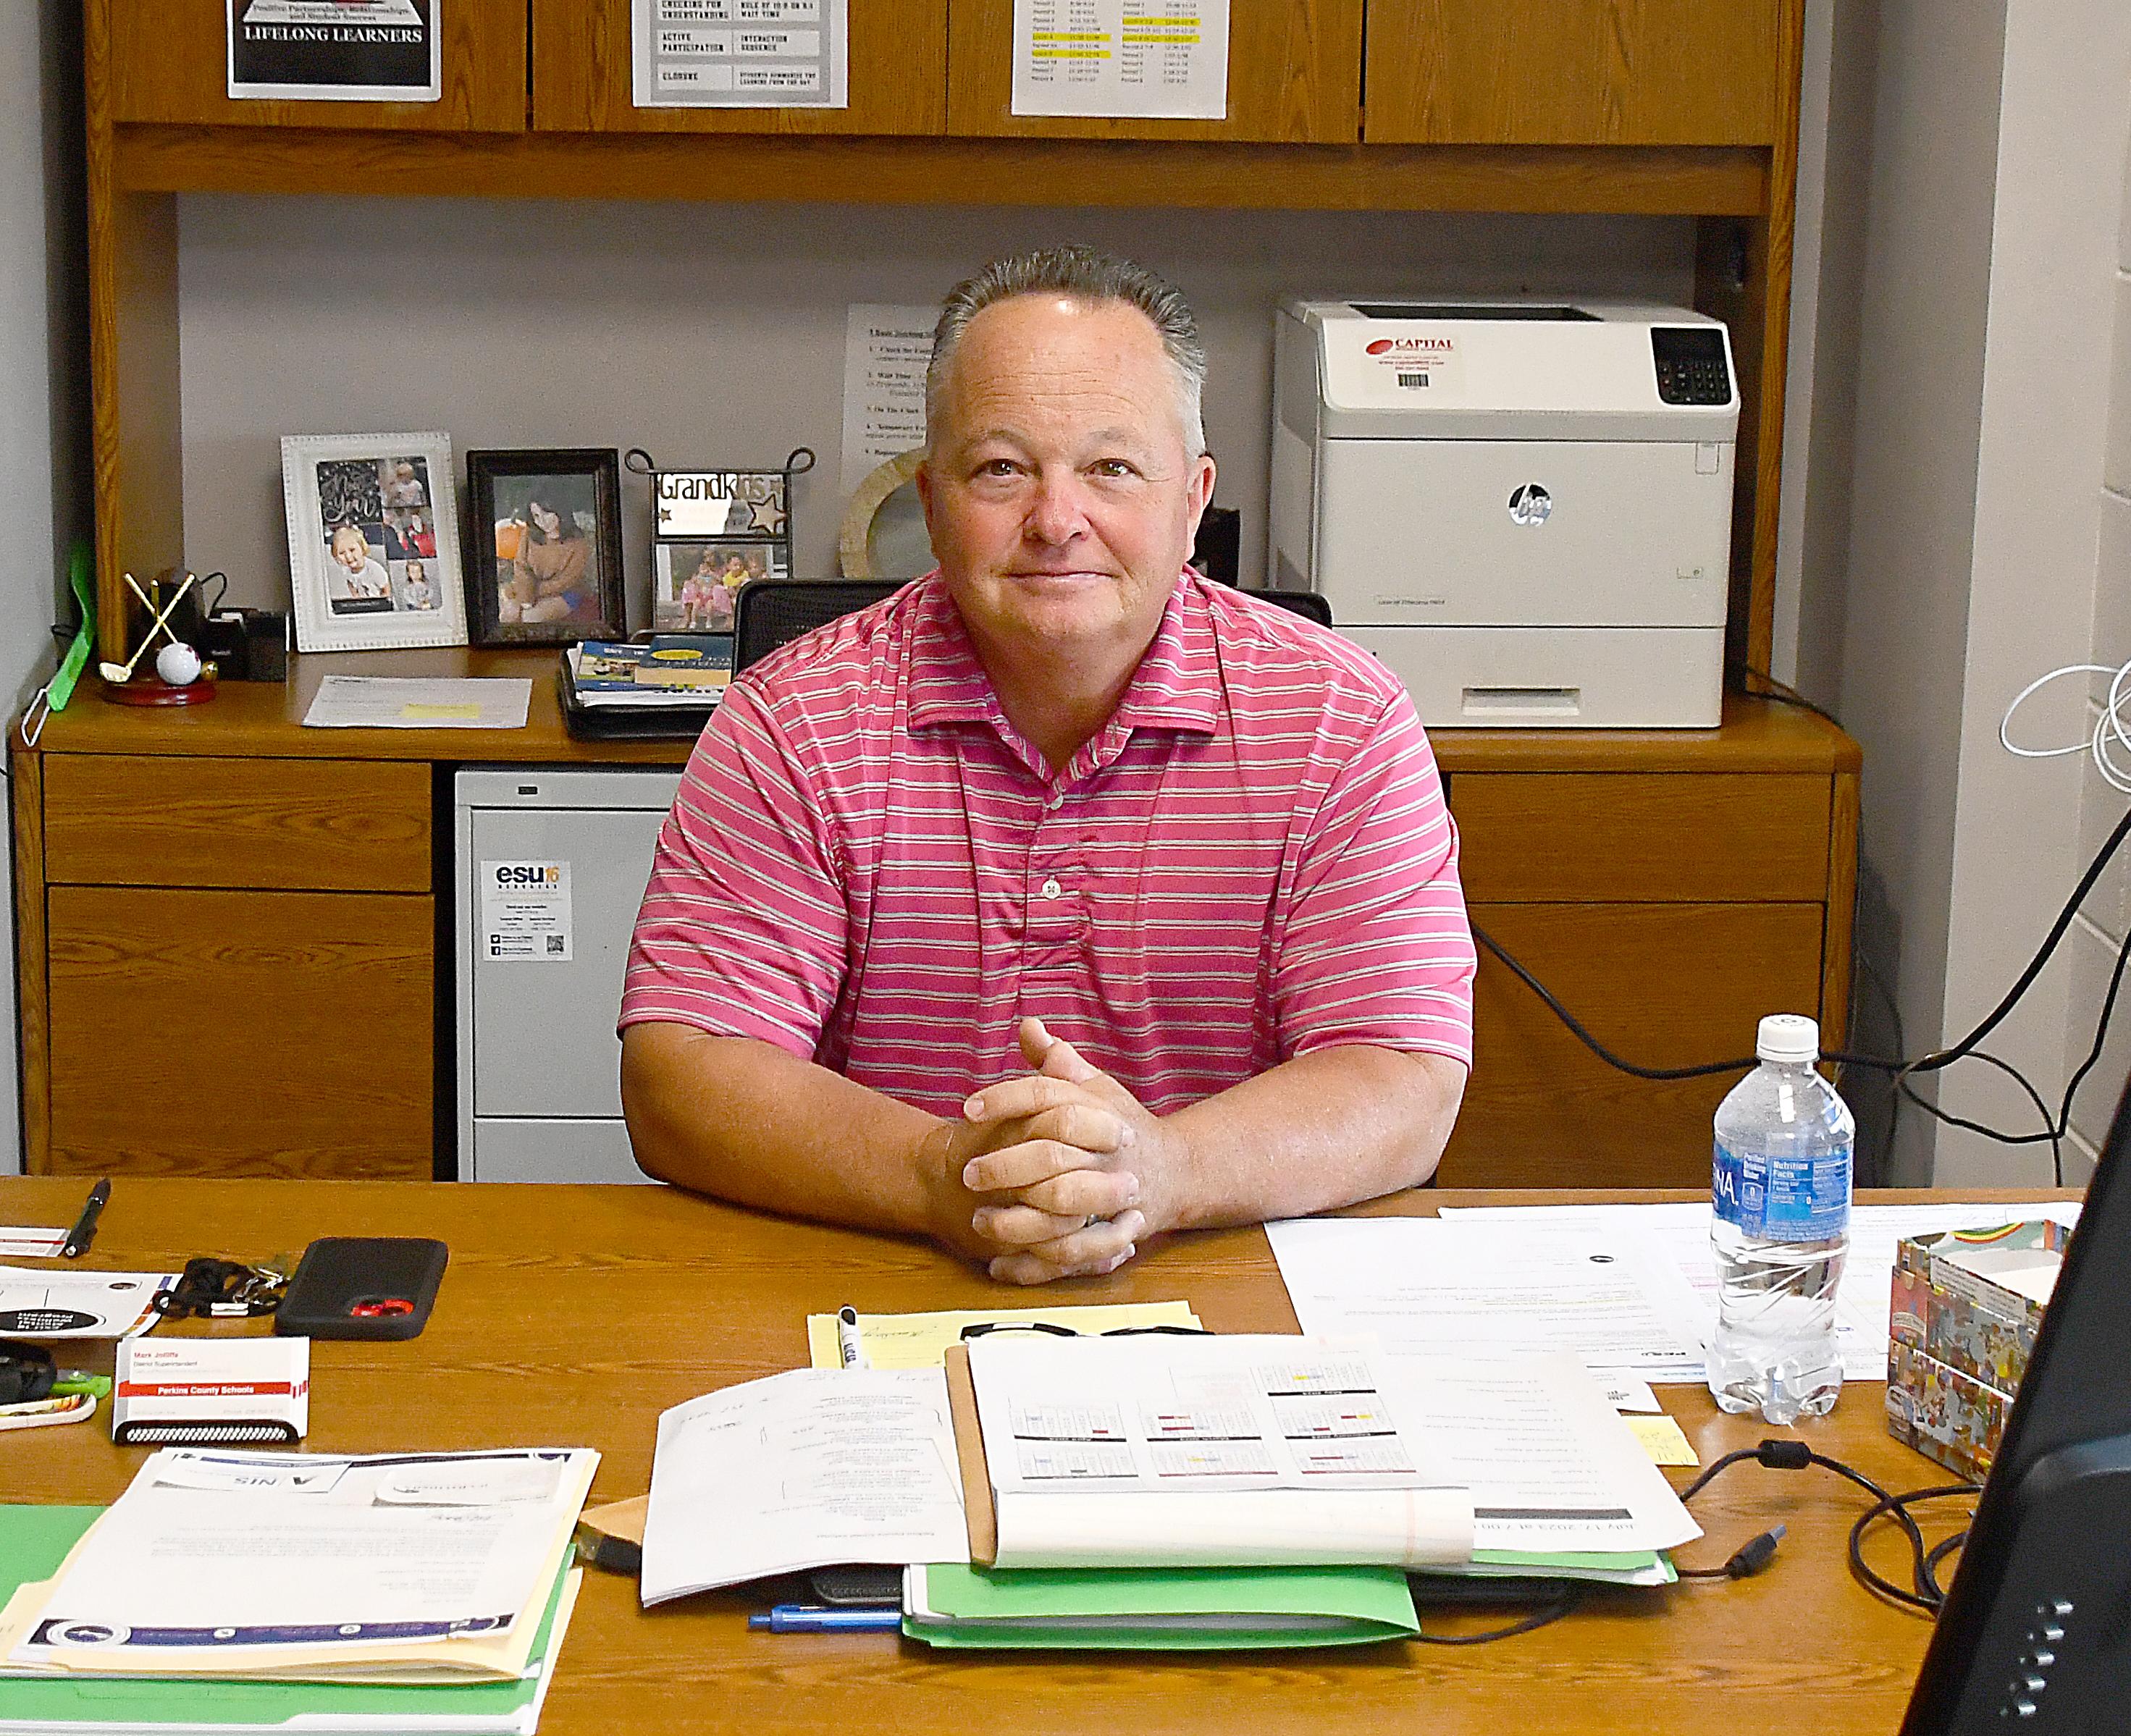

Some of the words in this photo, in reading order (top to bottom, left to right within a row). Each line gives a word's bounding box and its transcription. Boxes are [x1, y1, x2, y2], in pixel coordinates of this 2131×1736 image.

[244, 27, 329, 41] LIFELONG
[334, 28, 423, 42] LEARNERS
[663, 33, 691, 41] ACTIVE
[1395, 339, 1453, 348] CAPITAL
[1510, 484, 1551, 526] hp
[1774, 1161, 1808, 1171] Nutrition
[1774, 1170, 1795, 1179] Facts
[158, 1386, 188, 1395] Perkins
[190, 1386, 219, 1396] County
[221, 1386, 255, 1394] Schools
